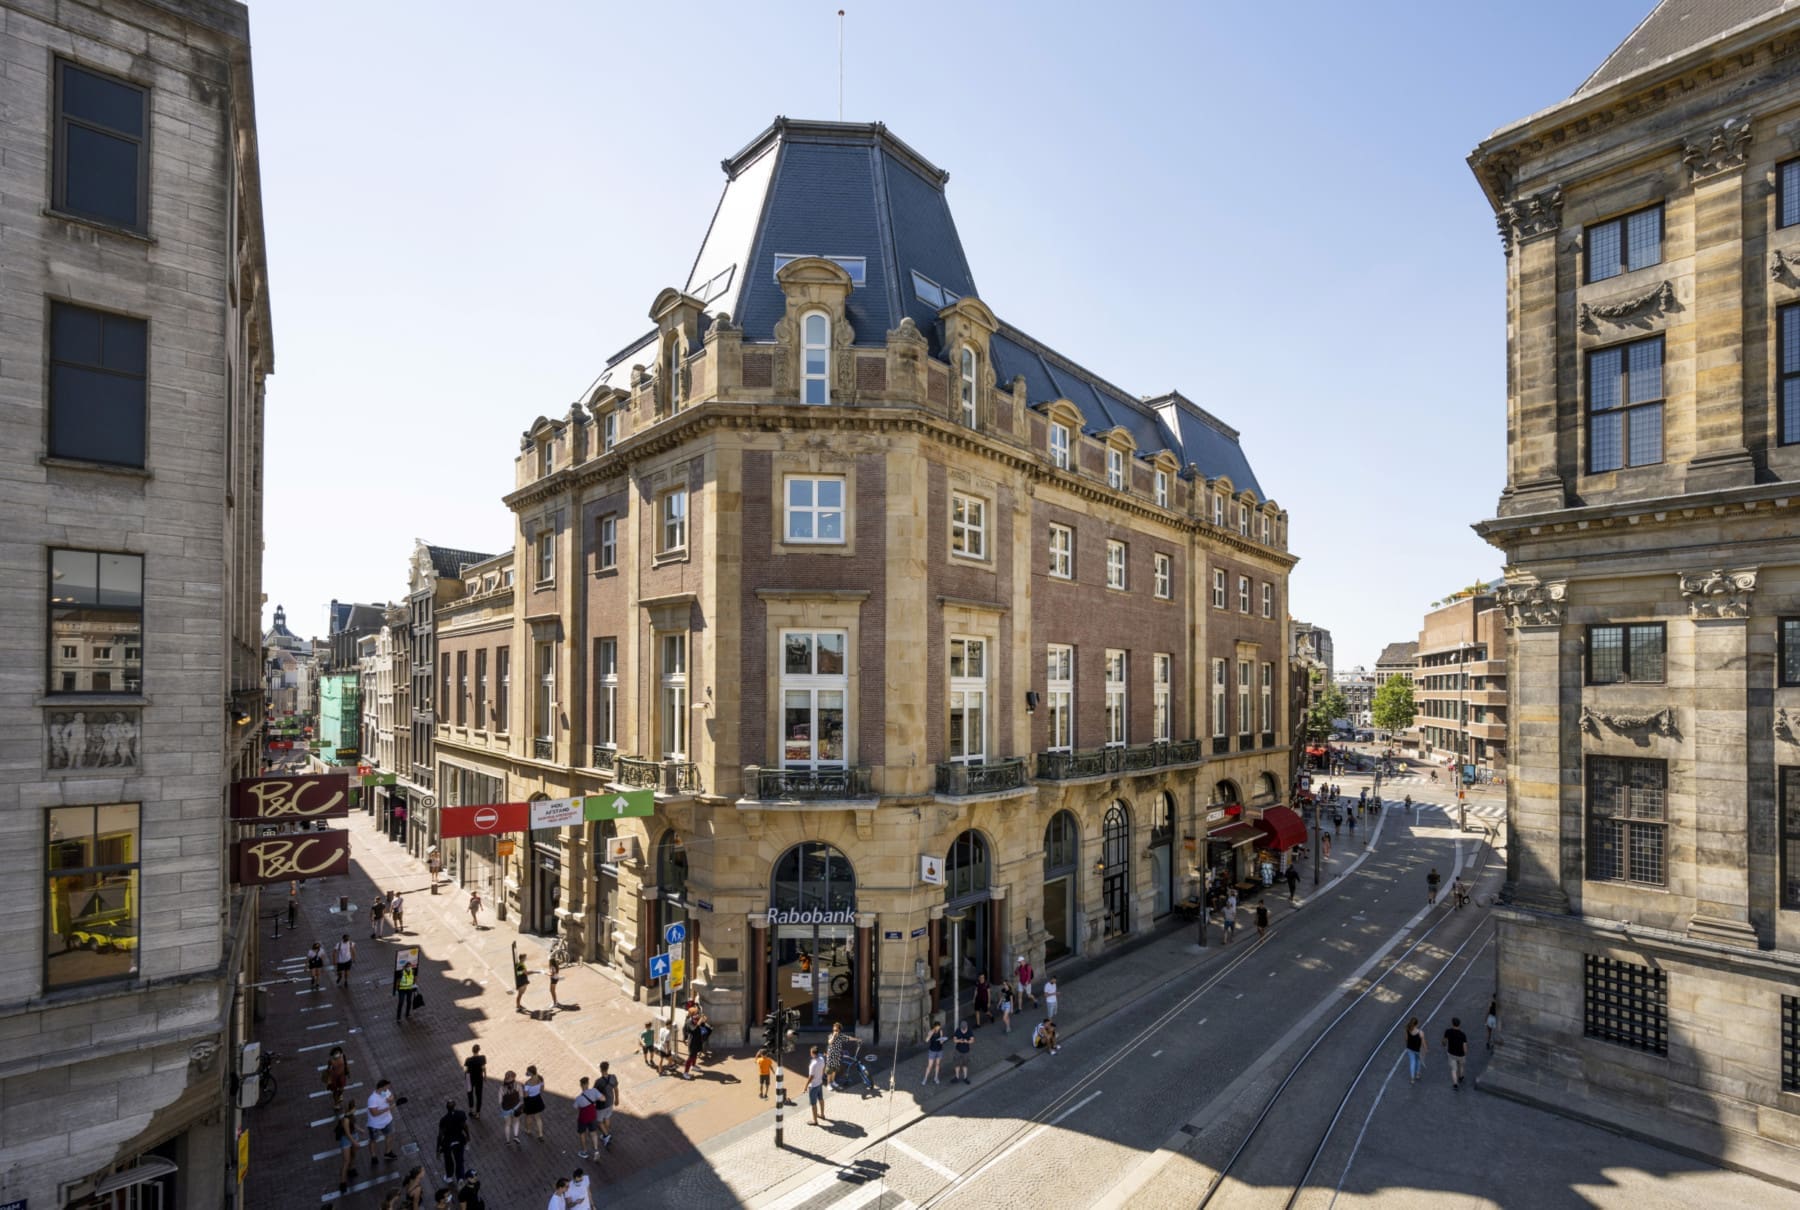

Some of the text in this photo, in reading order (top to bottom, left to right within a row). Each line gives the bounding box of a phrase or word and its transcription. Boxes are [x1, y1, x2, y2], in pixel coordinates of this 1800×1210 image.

[248, 781, 344, 817] P&C
[248, 839, 344, 878] P&C
[767, 906, 855, 924] Rabobank
